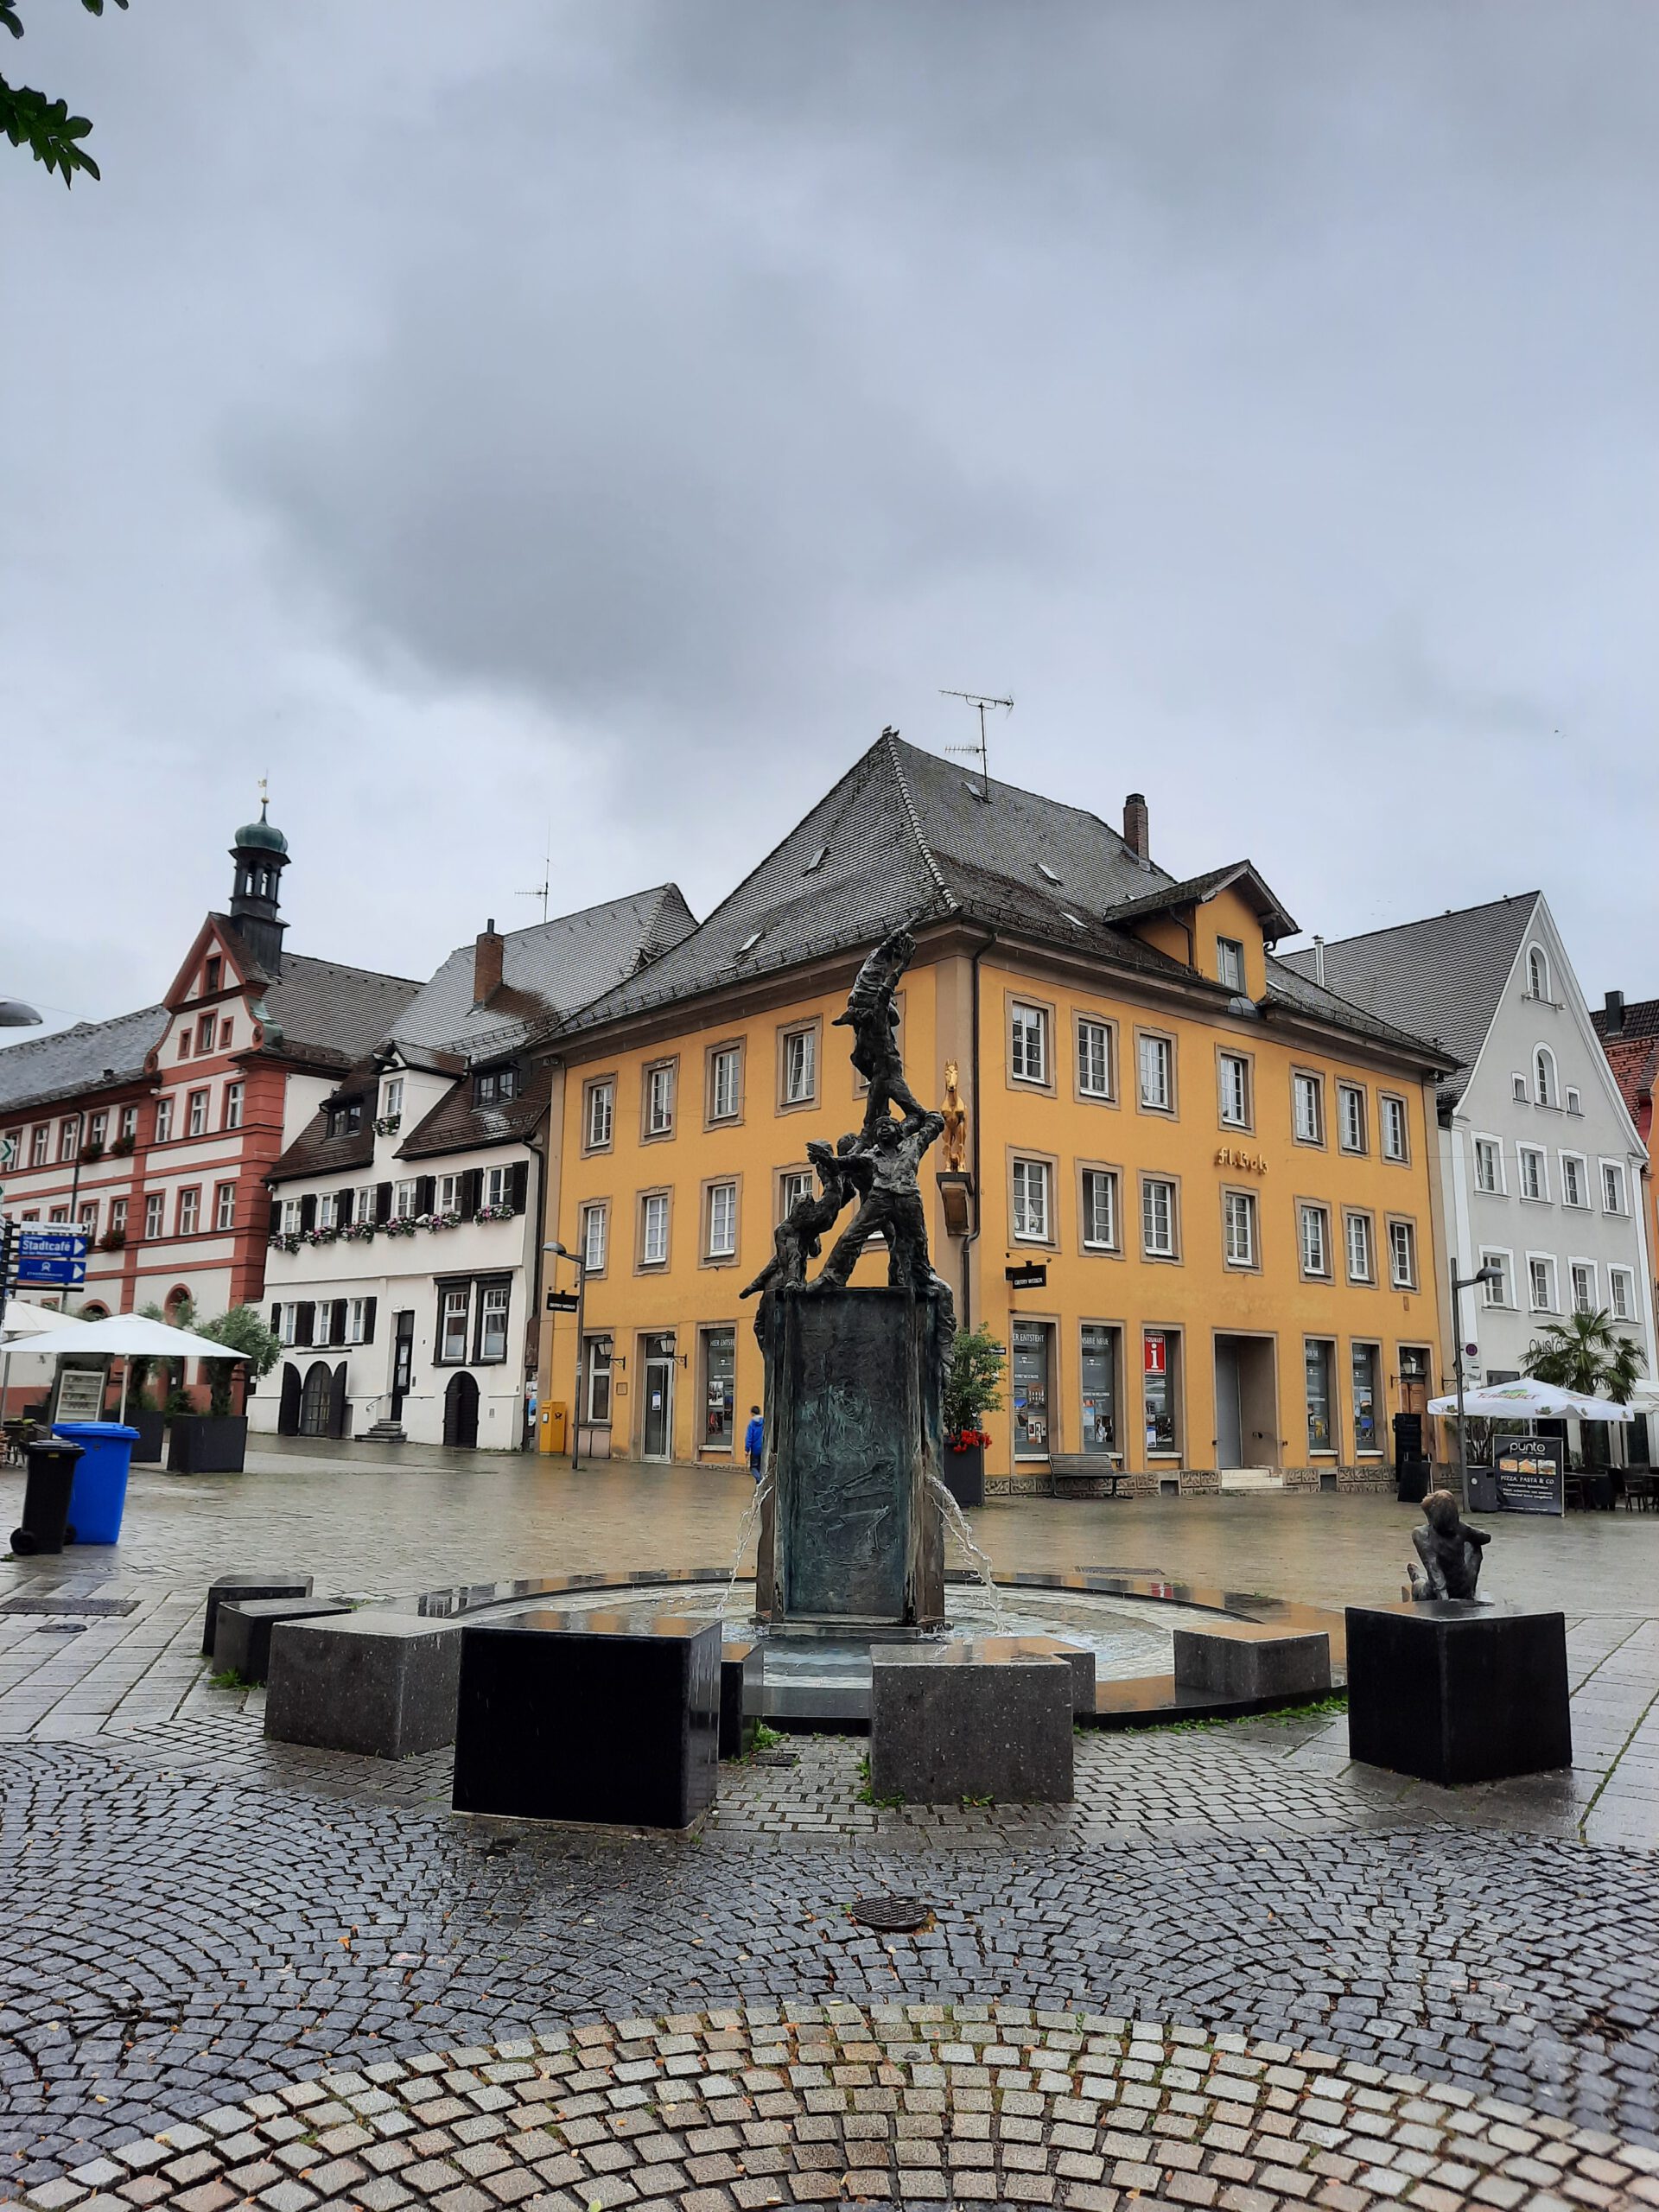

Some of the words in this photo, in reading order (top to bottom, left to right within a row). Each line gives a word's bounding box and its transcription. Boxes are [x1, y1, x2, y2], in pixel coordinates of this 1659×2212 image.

[22, 1239, 71, 1252] Stadtcafé
[720, 1338, 735, 1347] ENTSTE
[1020, 1333, 1045, 1343] ENTSTEHT
[1081, 1336, 1096, 1345] NSERE
[1096, 1337, 1109, 1345] NEUE
[1510, 1441, 1546, 1454] punto
